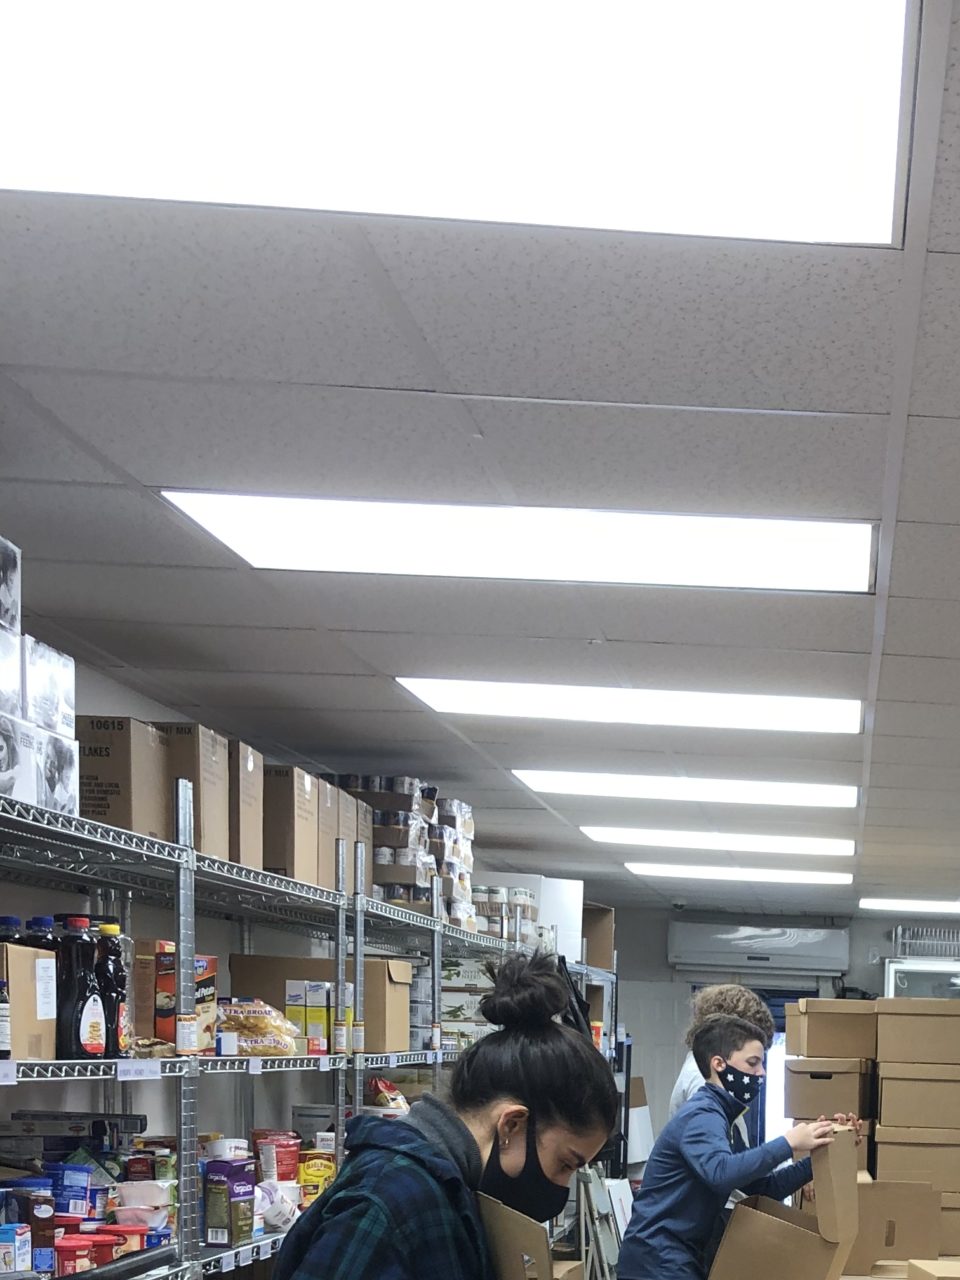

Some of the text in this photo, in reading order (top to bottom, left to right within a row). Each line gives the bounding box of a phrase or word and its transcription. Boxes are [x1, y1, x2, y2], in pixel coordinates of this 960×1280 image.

[90, 719, 124, 731] 10615
[176, 726, 193, 736] MIX
[223, 1007, 245, 1016] XTRA
